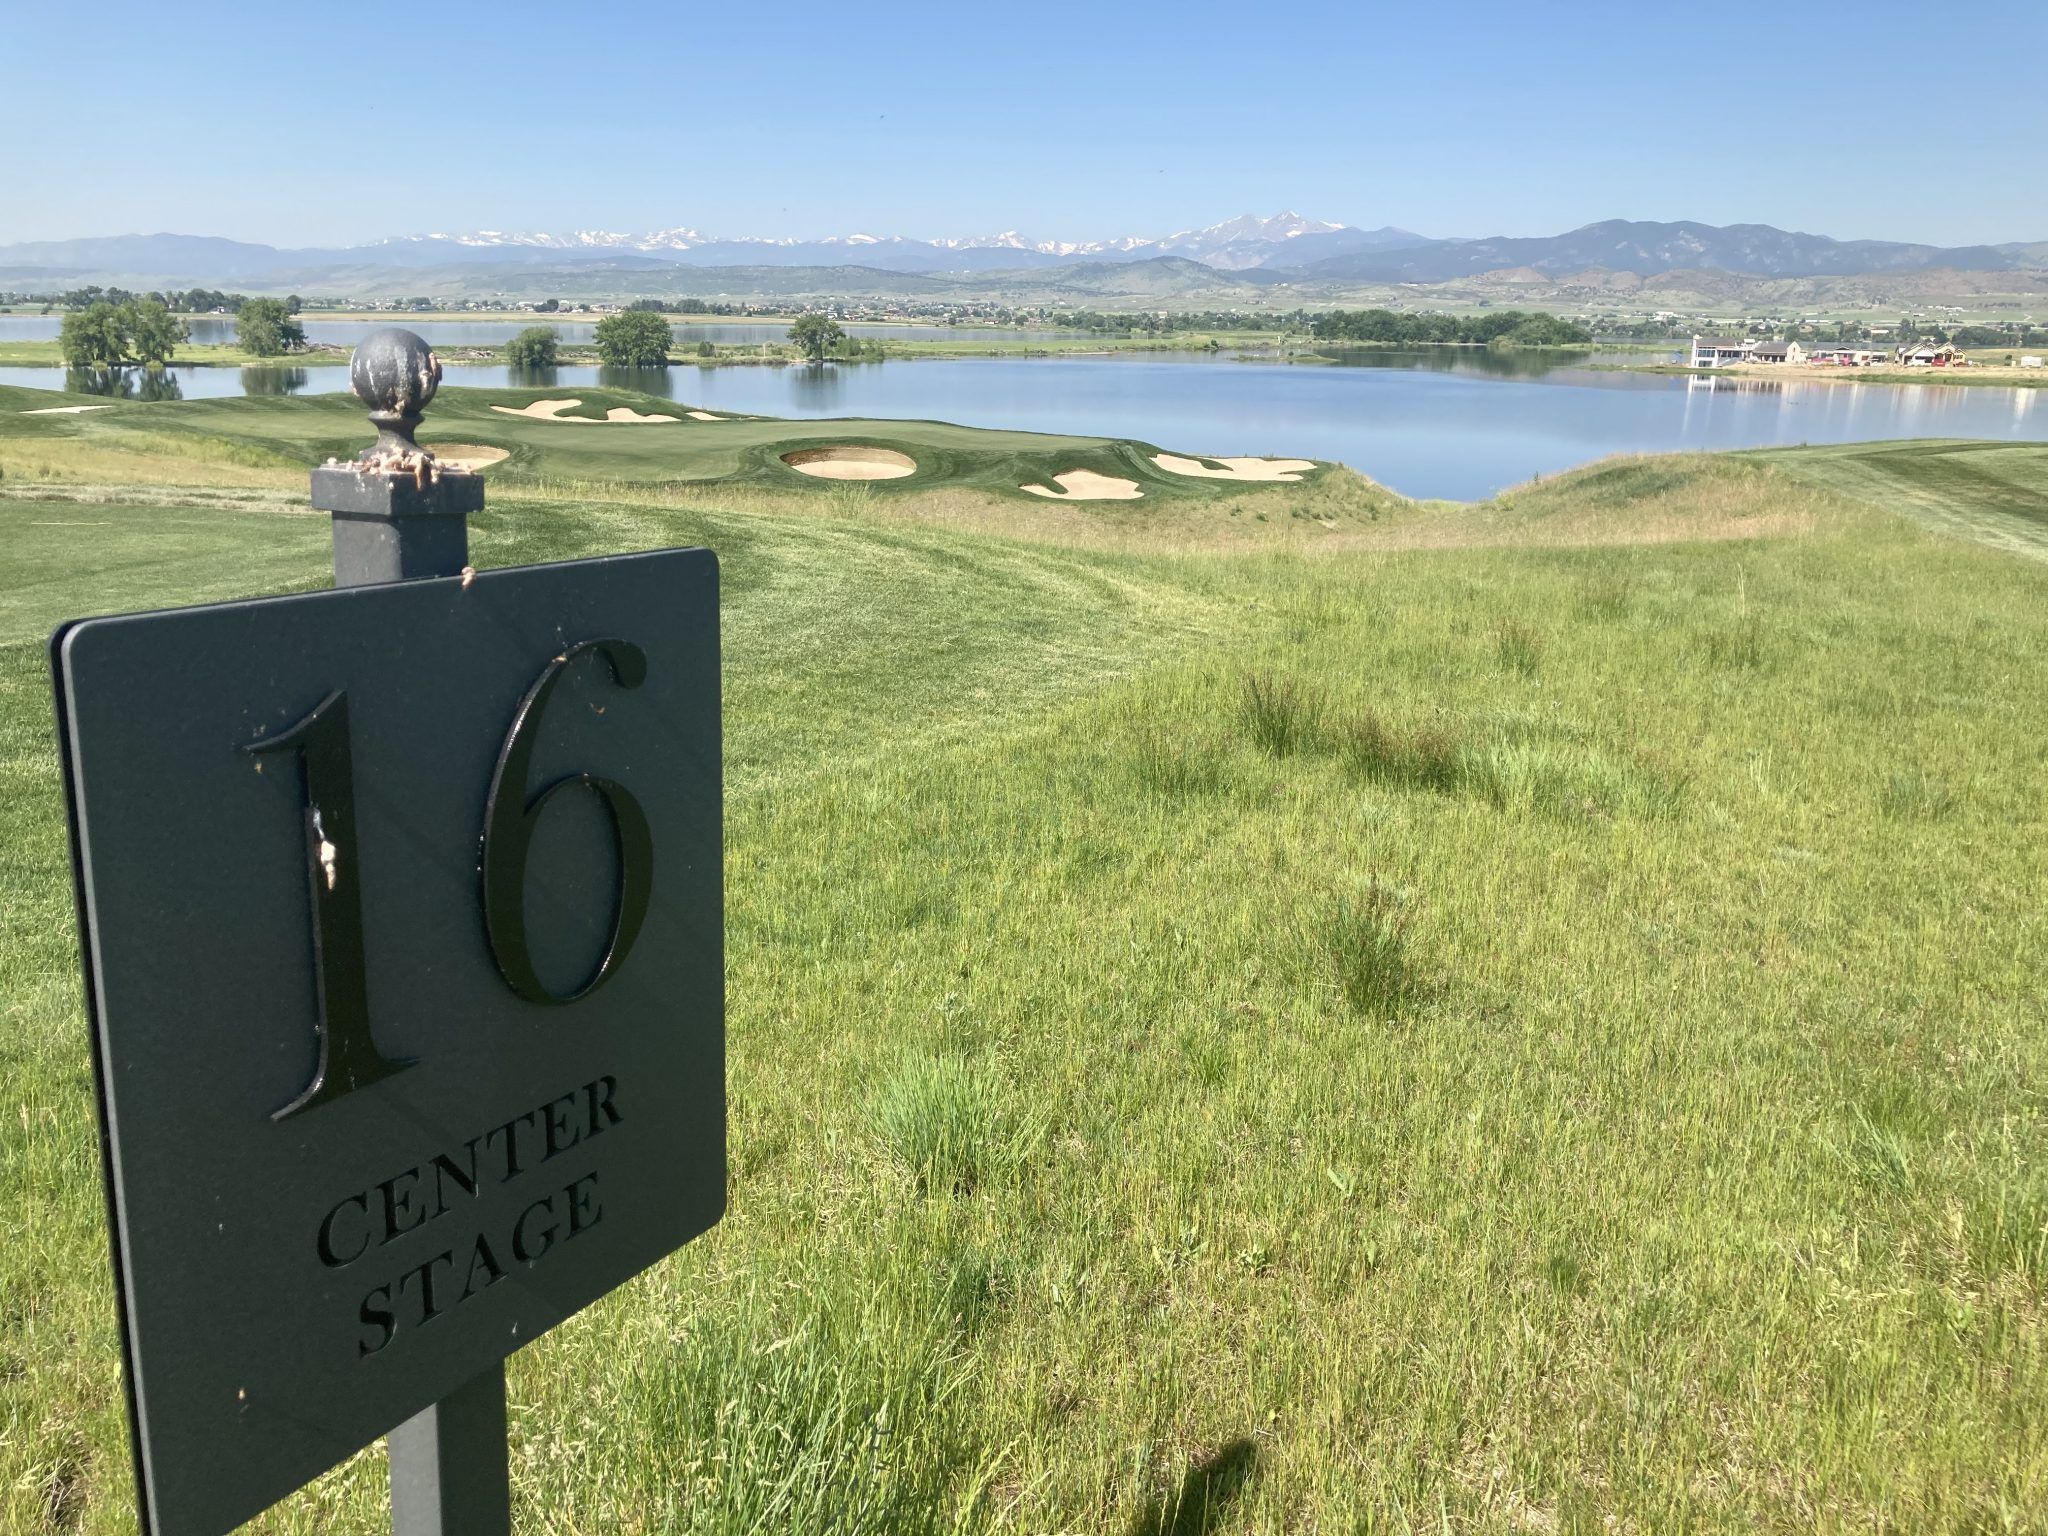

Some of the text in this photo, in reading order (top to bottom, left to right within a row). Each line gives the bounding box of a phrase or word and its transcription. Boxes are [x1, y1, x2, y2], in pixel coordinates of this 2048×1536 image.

[241, 637, 653, 1122] 16
[316, 1074, 624, 1269] CENTER
[357, 1170, 601, 1358] STAGE
